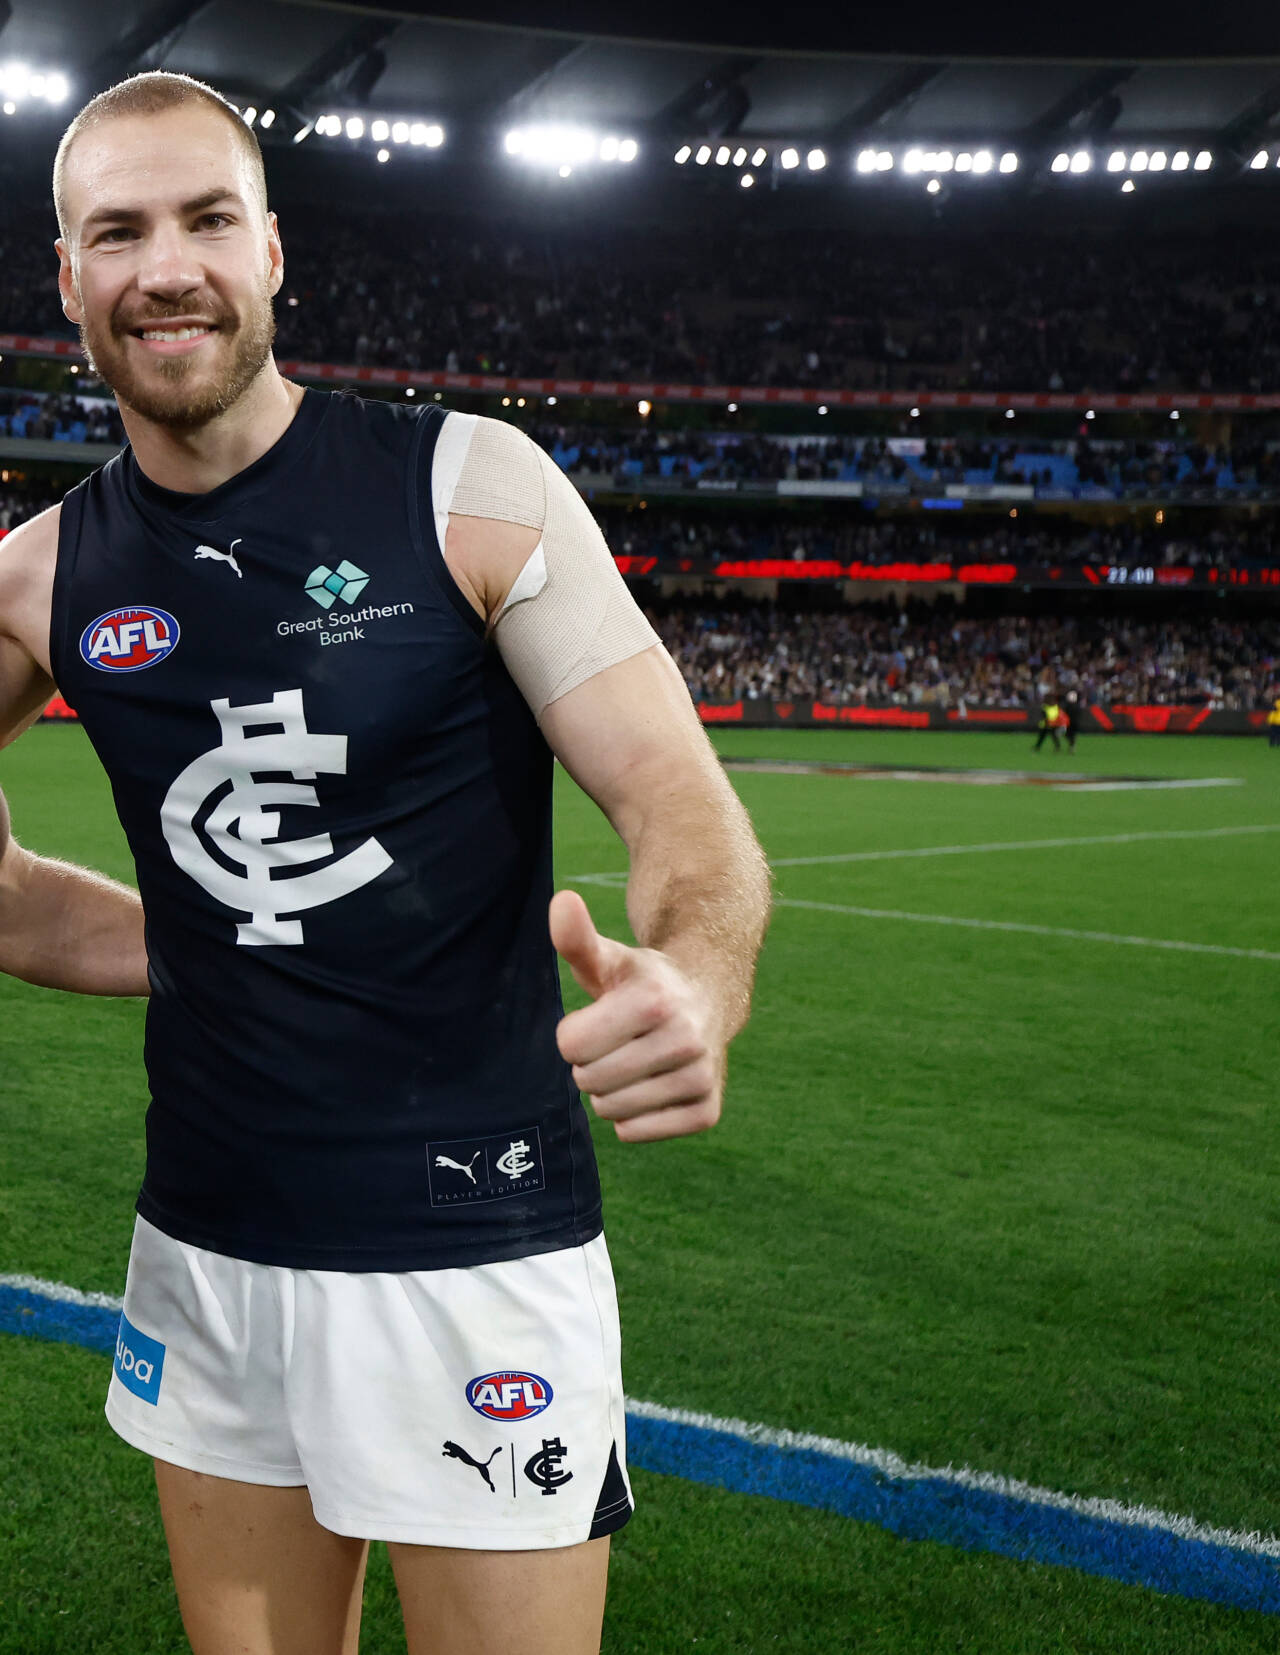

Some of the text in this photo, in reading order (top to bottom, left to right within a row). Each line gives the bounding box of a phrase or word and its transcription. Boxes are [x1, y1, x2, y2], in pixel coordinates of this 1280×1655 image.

[276, 601, 415, 637] Great Southern
[88, 618, 172, 660] AFL
[319, 626, 366, 647] Bank
[437, 1178, 539, 1201] PLAYER EDITION
[472, 1381, 548, 1409] AFL
